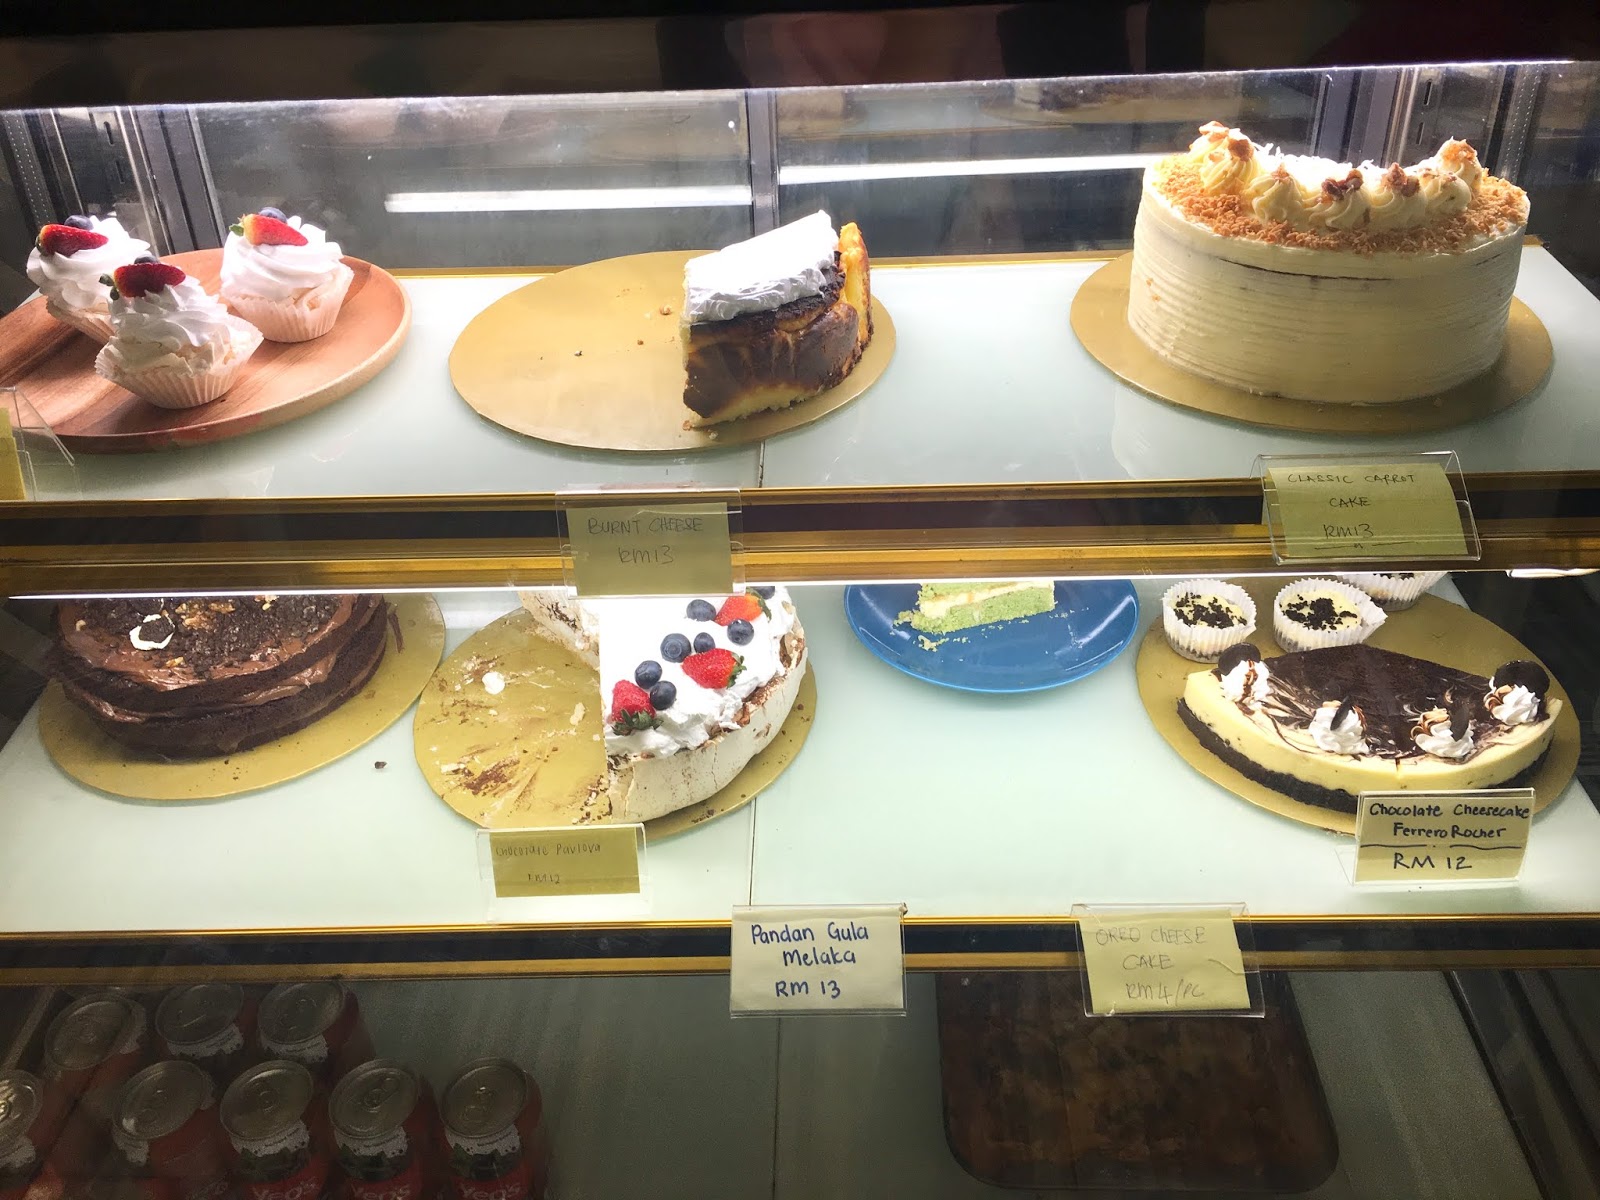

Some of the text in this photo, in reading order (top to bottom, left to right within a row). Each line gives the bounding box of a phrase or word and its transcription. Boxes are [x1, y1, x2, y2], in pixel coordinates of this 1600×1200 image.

[1287, 473, 1416, 485] CLASSIC CARROT
[1329, 495, 1371, 508] CAKE
[587, 517, 704, 535] BURNT CHEESE
[1369, 802, 1530, 819] Chocolate Cheesecake
[1393, 822, 1507, 839] Ferrero Rocher
[1393, 852, 1472, 870] RM 12
[751, 921, 869, 945] Pandan Gula
[1095, 926, 1141, 946] OREO
[782, 946, 857, 967] Melaka
[1122, 954, 1174, 971] CAKE
[775, 980, 841, 999] RM 13
